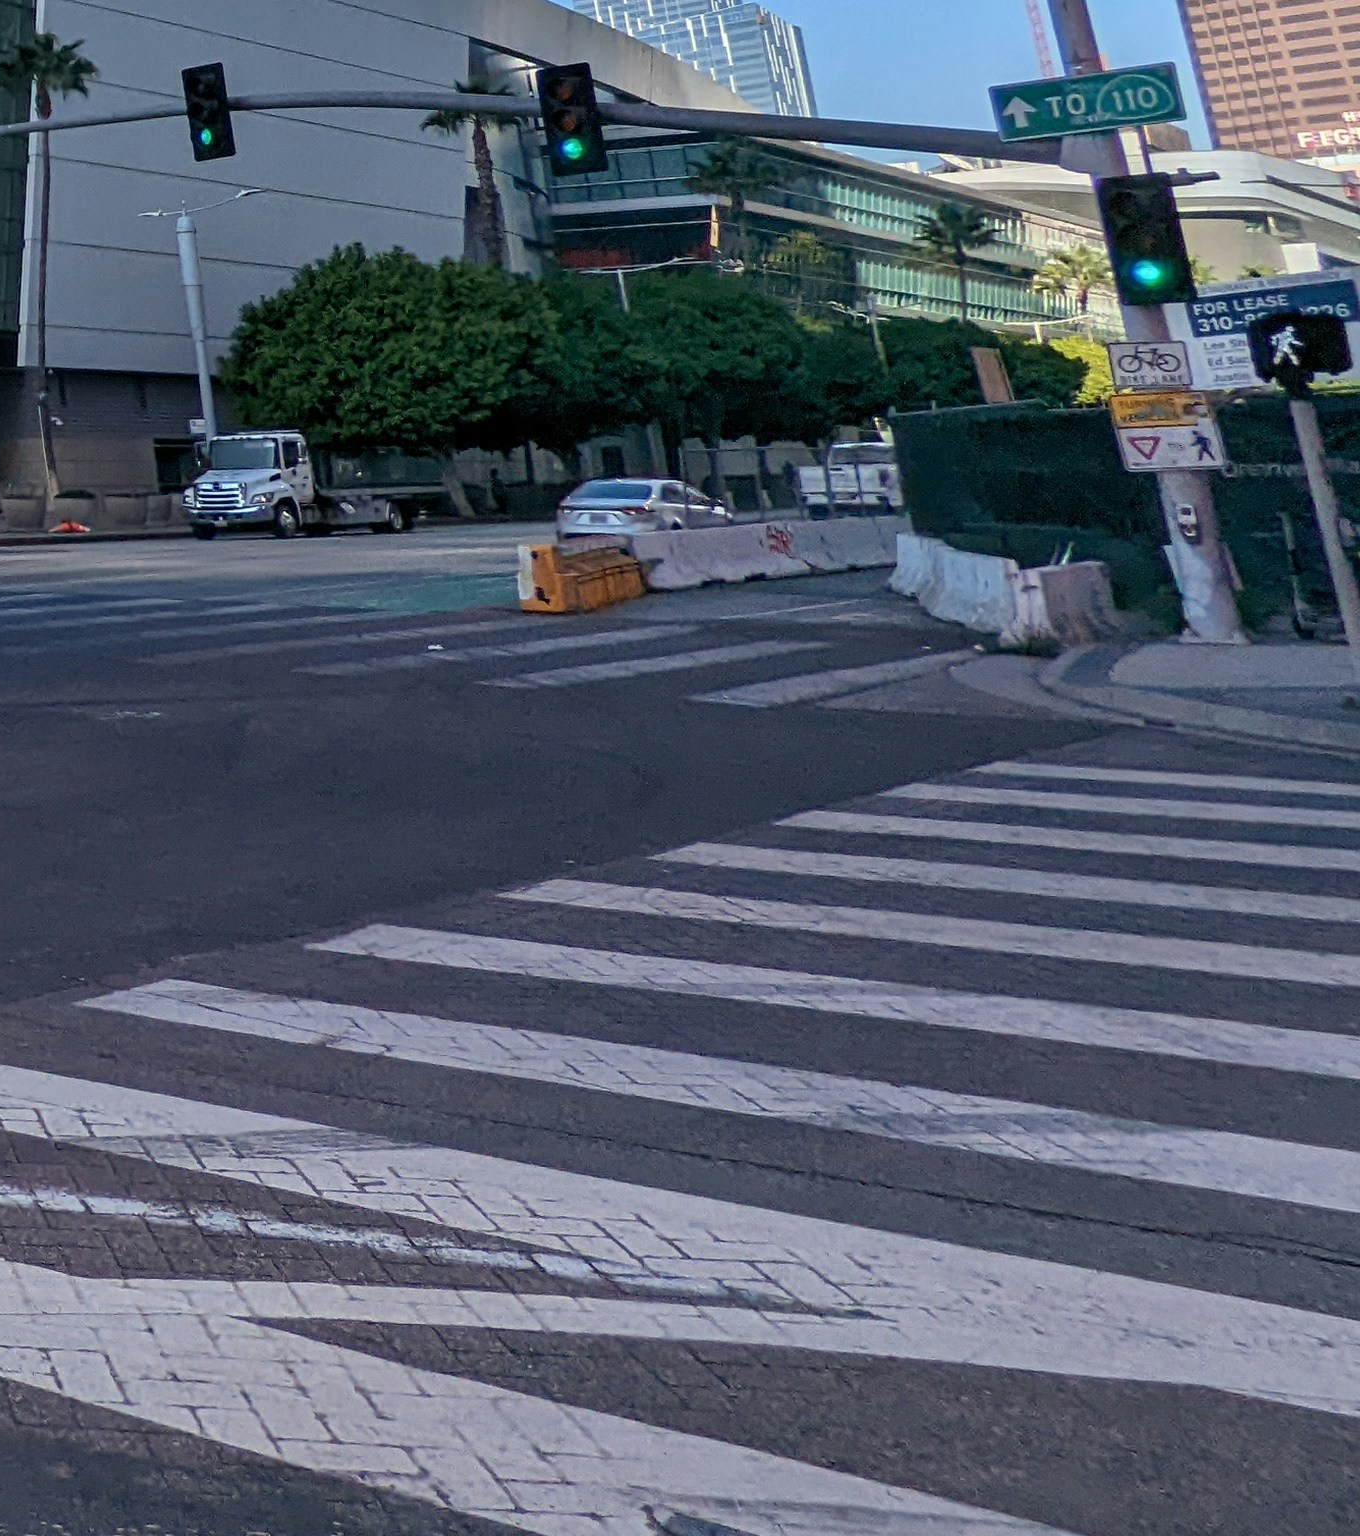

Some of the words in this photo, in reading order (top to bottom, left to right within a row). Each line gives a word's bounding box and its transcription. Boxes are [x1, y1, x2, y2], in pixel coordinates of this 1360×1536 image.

[1045, 93, 1086, 117] TO
[1111, 86, 1157, 112] 110
[1192, 301, 1228, 316] FOR
[1233, 294, 1289, 311] LEASE
